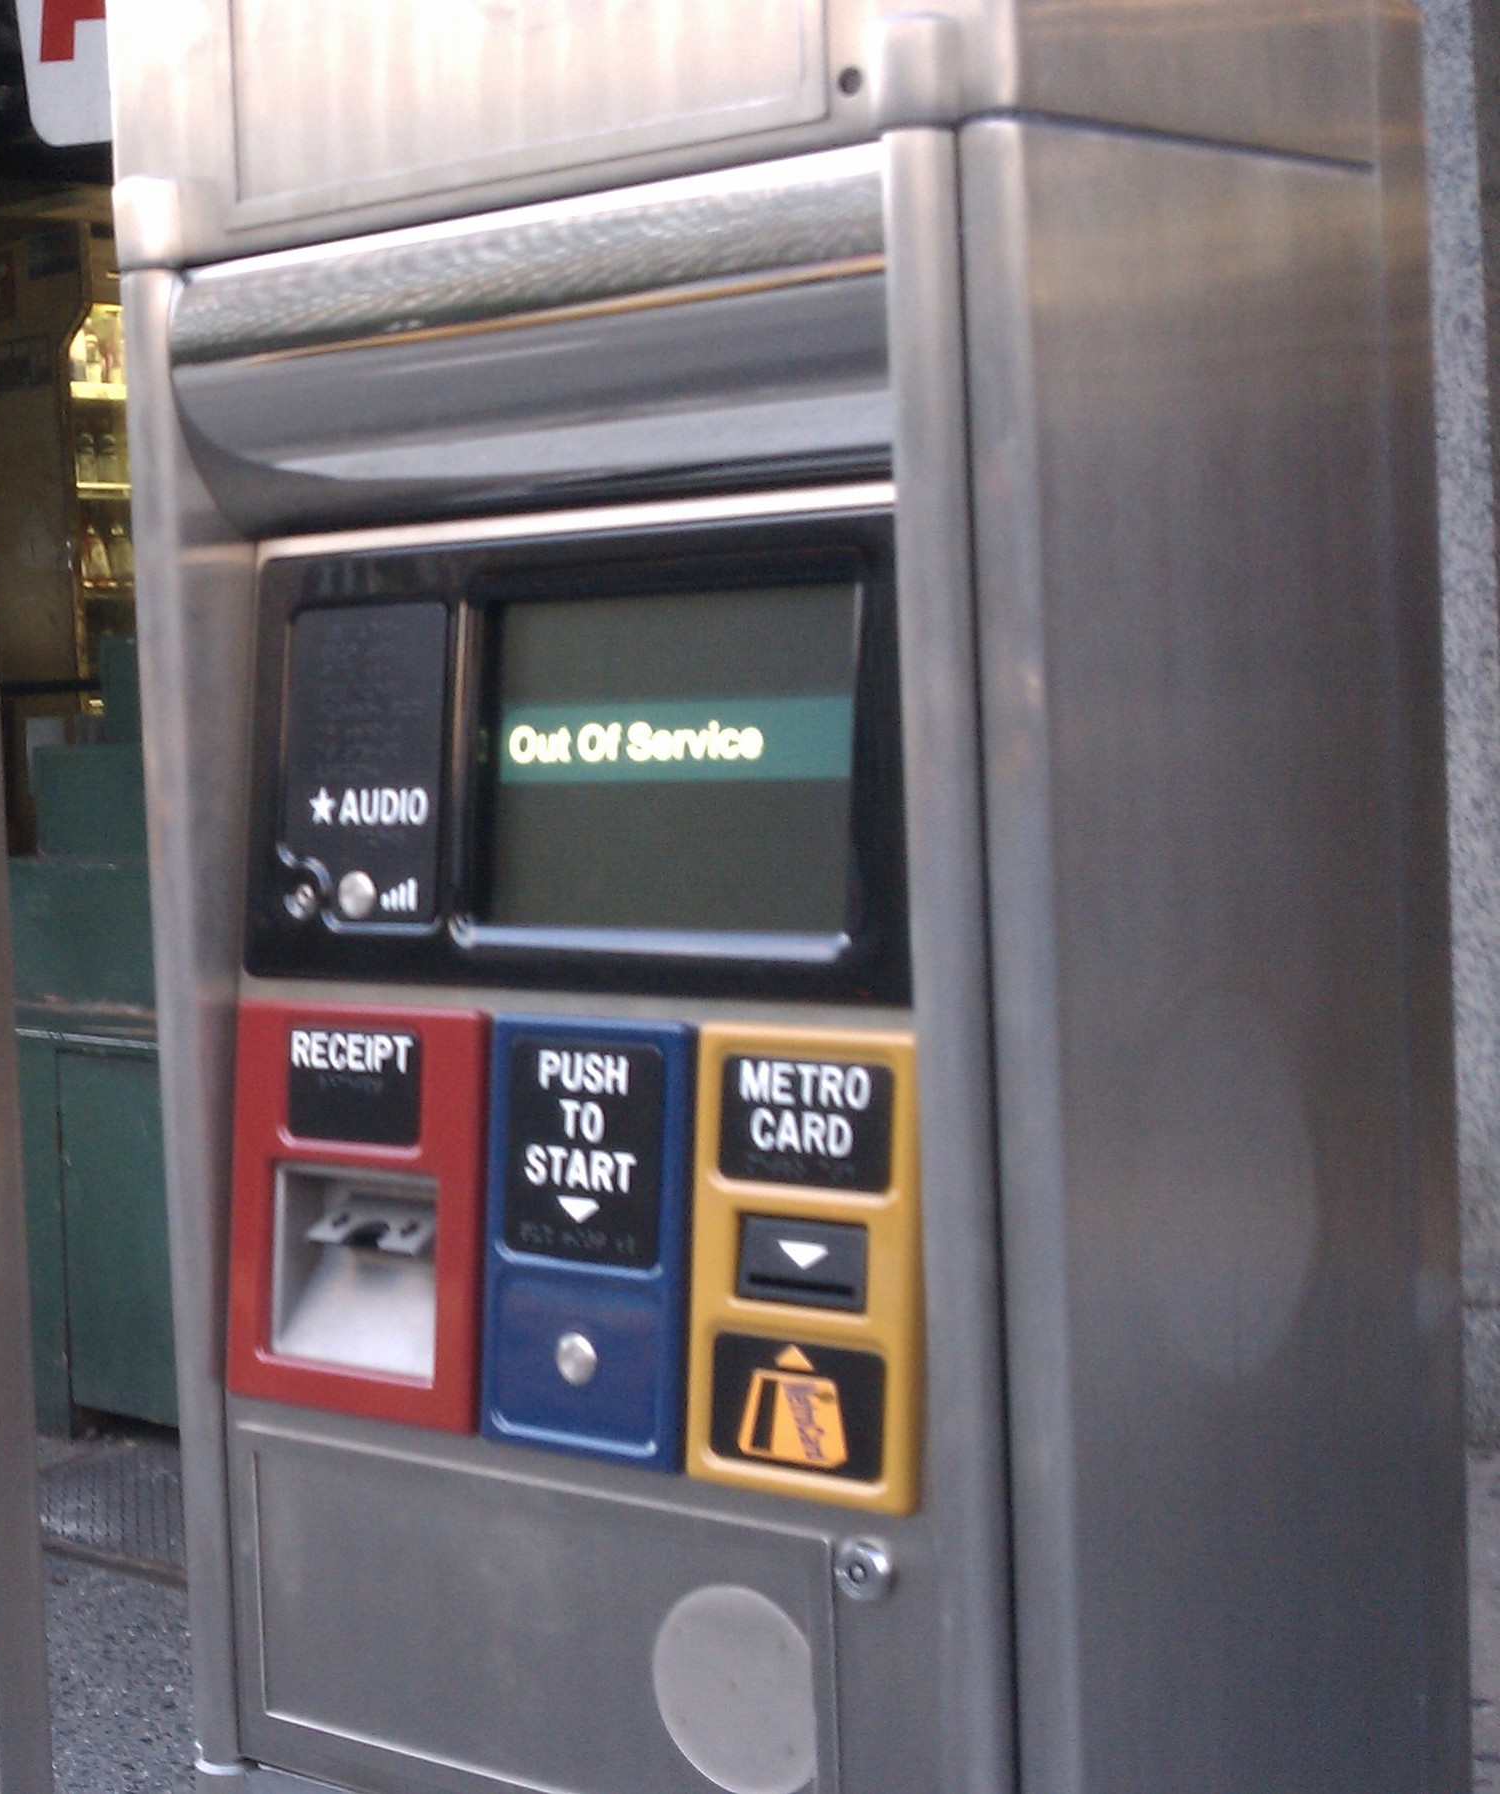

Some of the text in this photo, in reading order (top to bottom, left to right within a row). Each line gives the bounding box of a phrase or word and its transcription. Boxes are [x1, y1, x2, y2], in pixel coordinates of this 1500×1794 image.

[509, 720, 764, 765] Out Of Service
[338, 786, 430, 827] AUDIO
[289, 1028, 414, 1076] RECEIPT
[537, 1048, 630, 1098] PUSH
[738, 1057, 873, 1111] METRO
[560, 1097, 605, 1144] TO
[749, 1107, 854, 1158] CARD
[522, 1142, 638, 1195] START
